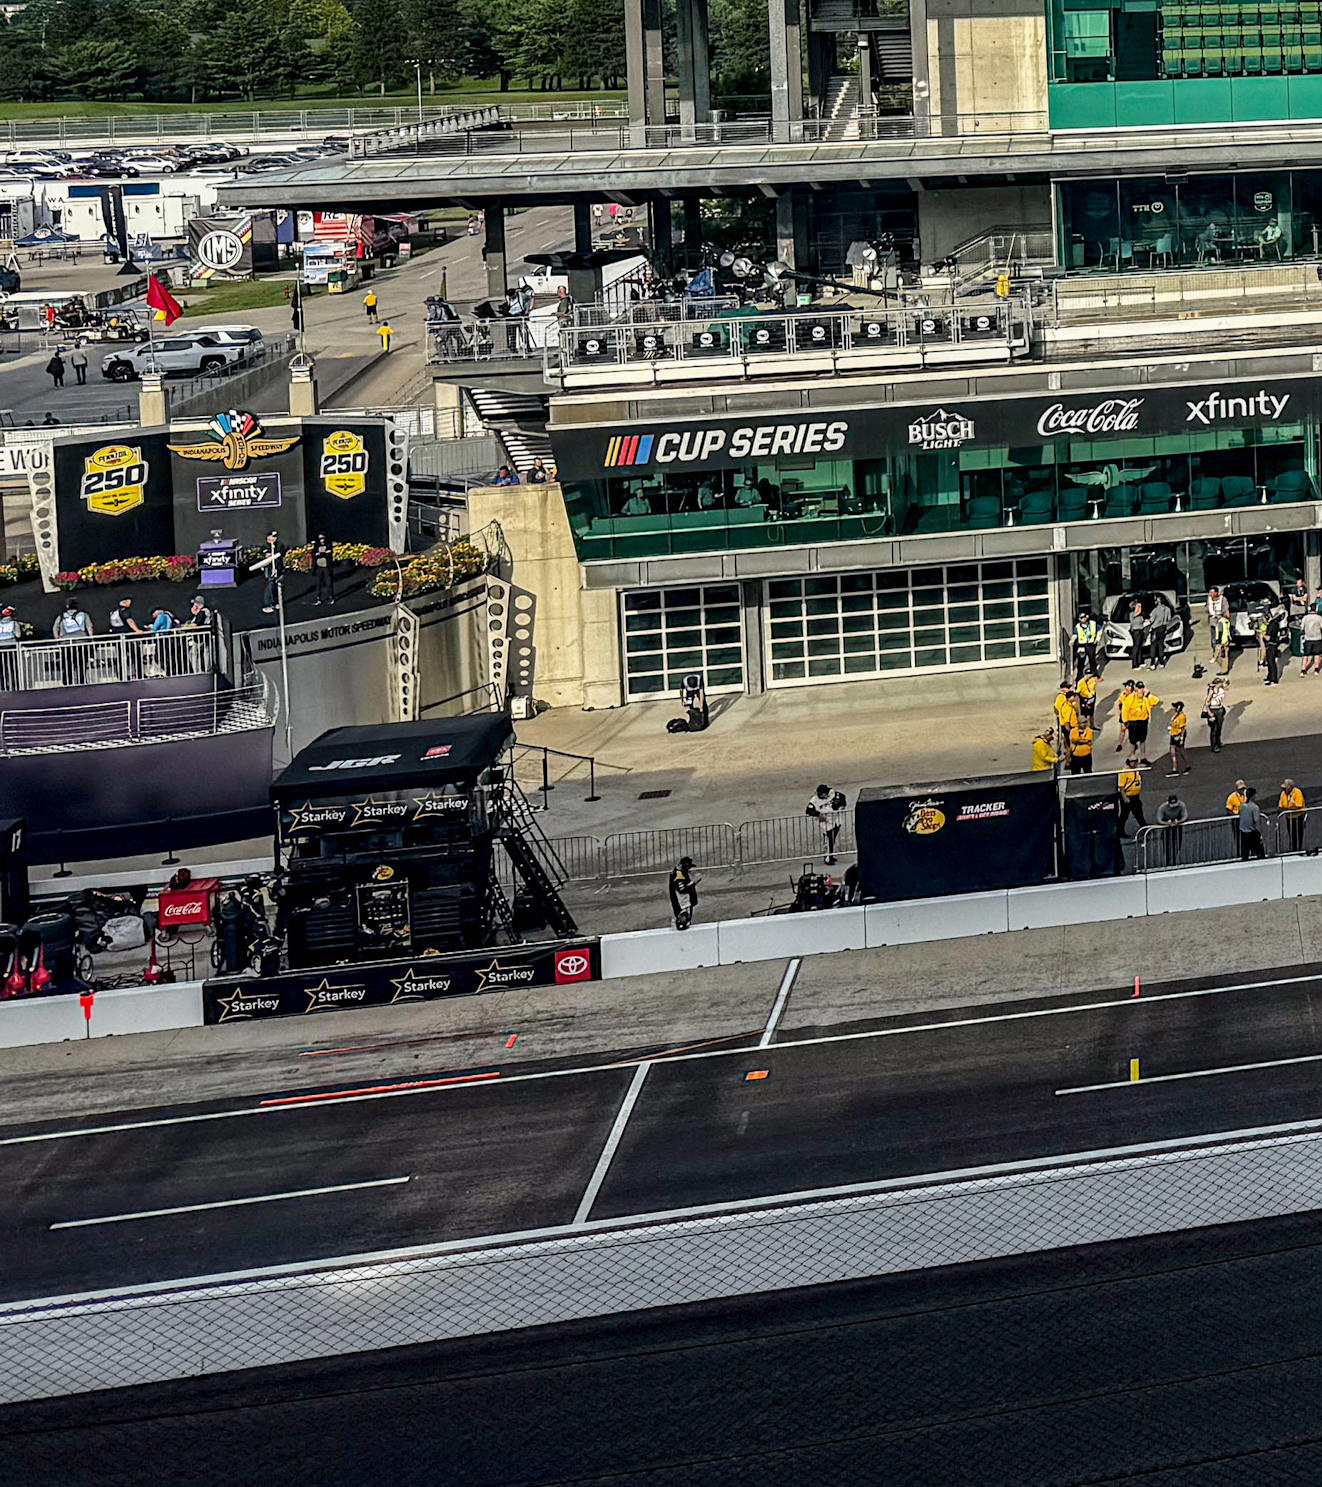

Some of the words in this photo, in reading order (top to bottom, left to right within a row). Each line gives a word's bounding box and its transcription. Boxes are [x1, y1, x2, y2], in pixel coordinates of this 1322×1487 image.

[206, 234, 237, 263] IMS
[1186, 389, 1290, 424] xfinity
[908, 419, 975, 444] BUSCH
[655, 429, 727, 463] CUP
[728, 422, 848, 457] SERIES
[323, 452, 366, 474] 250
[84, 463, 145, 495] 250
[210, 485, 268, 504] xfinity
[321, 625, 350, 640] MOTOR
[352, 615, 392, 633] SPEEDWAY
[308, 753, 402, 772] JGR
[363, 804, 408, 818] Starkey
[425, 798, 469, 811] Starkey
[961, 802, 1005, 814] TRACKER
[301, 810, 346, 824] Starkey
[488, 968, 535, 983] Starkey
[404, 978, 451, 993] Starkey
[231, 997, 280, 1012] Starkey
[318, 988, 366, 1003] Starkey
